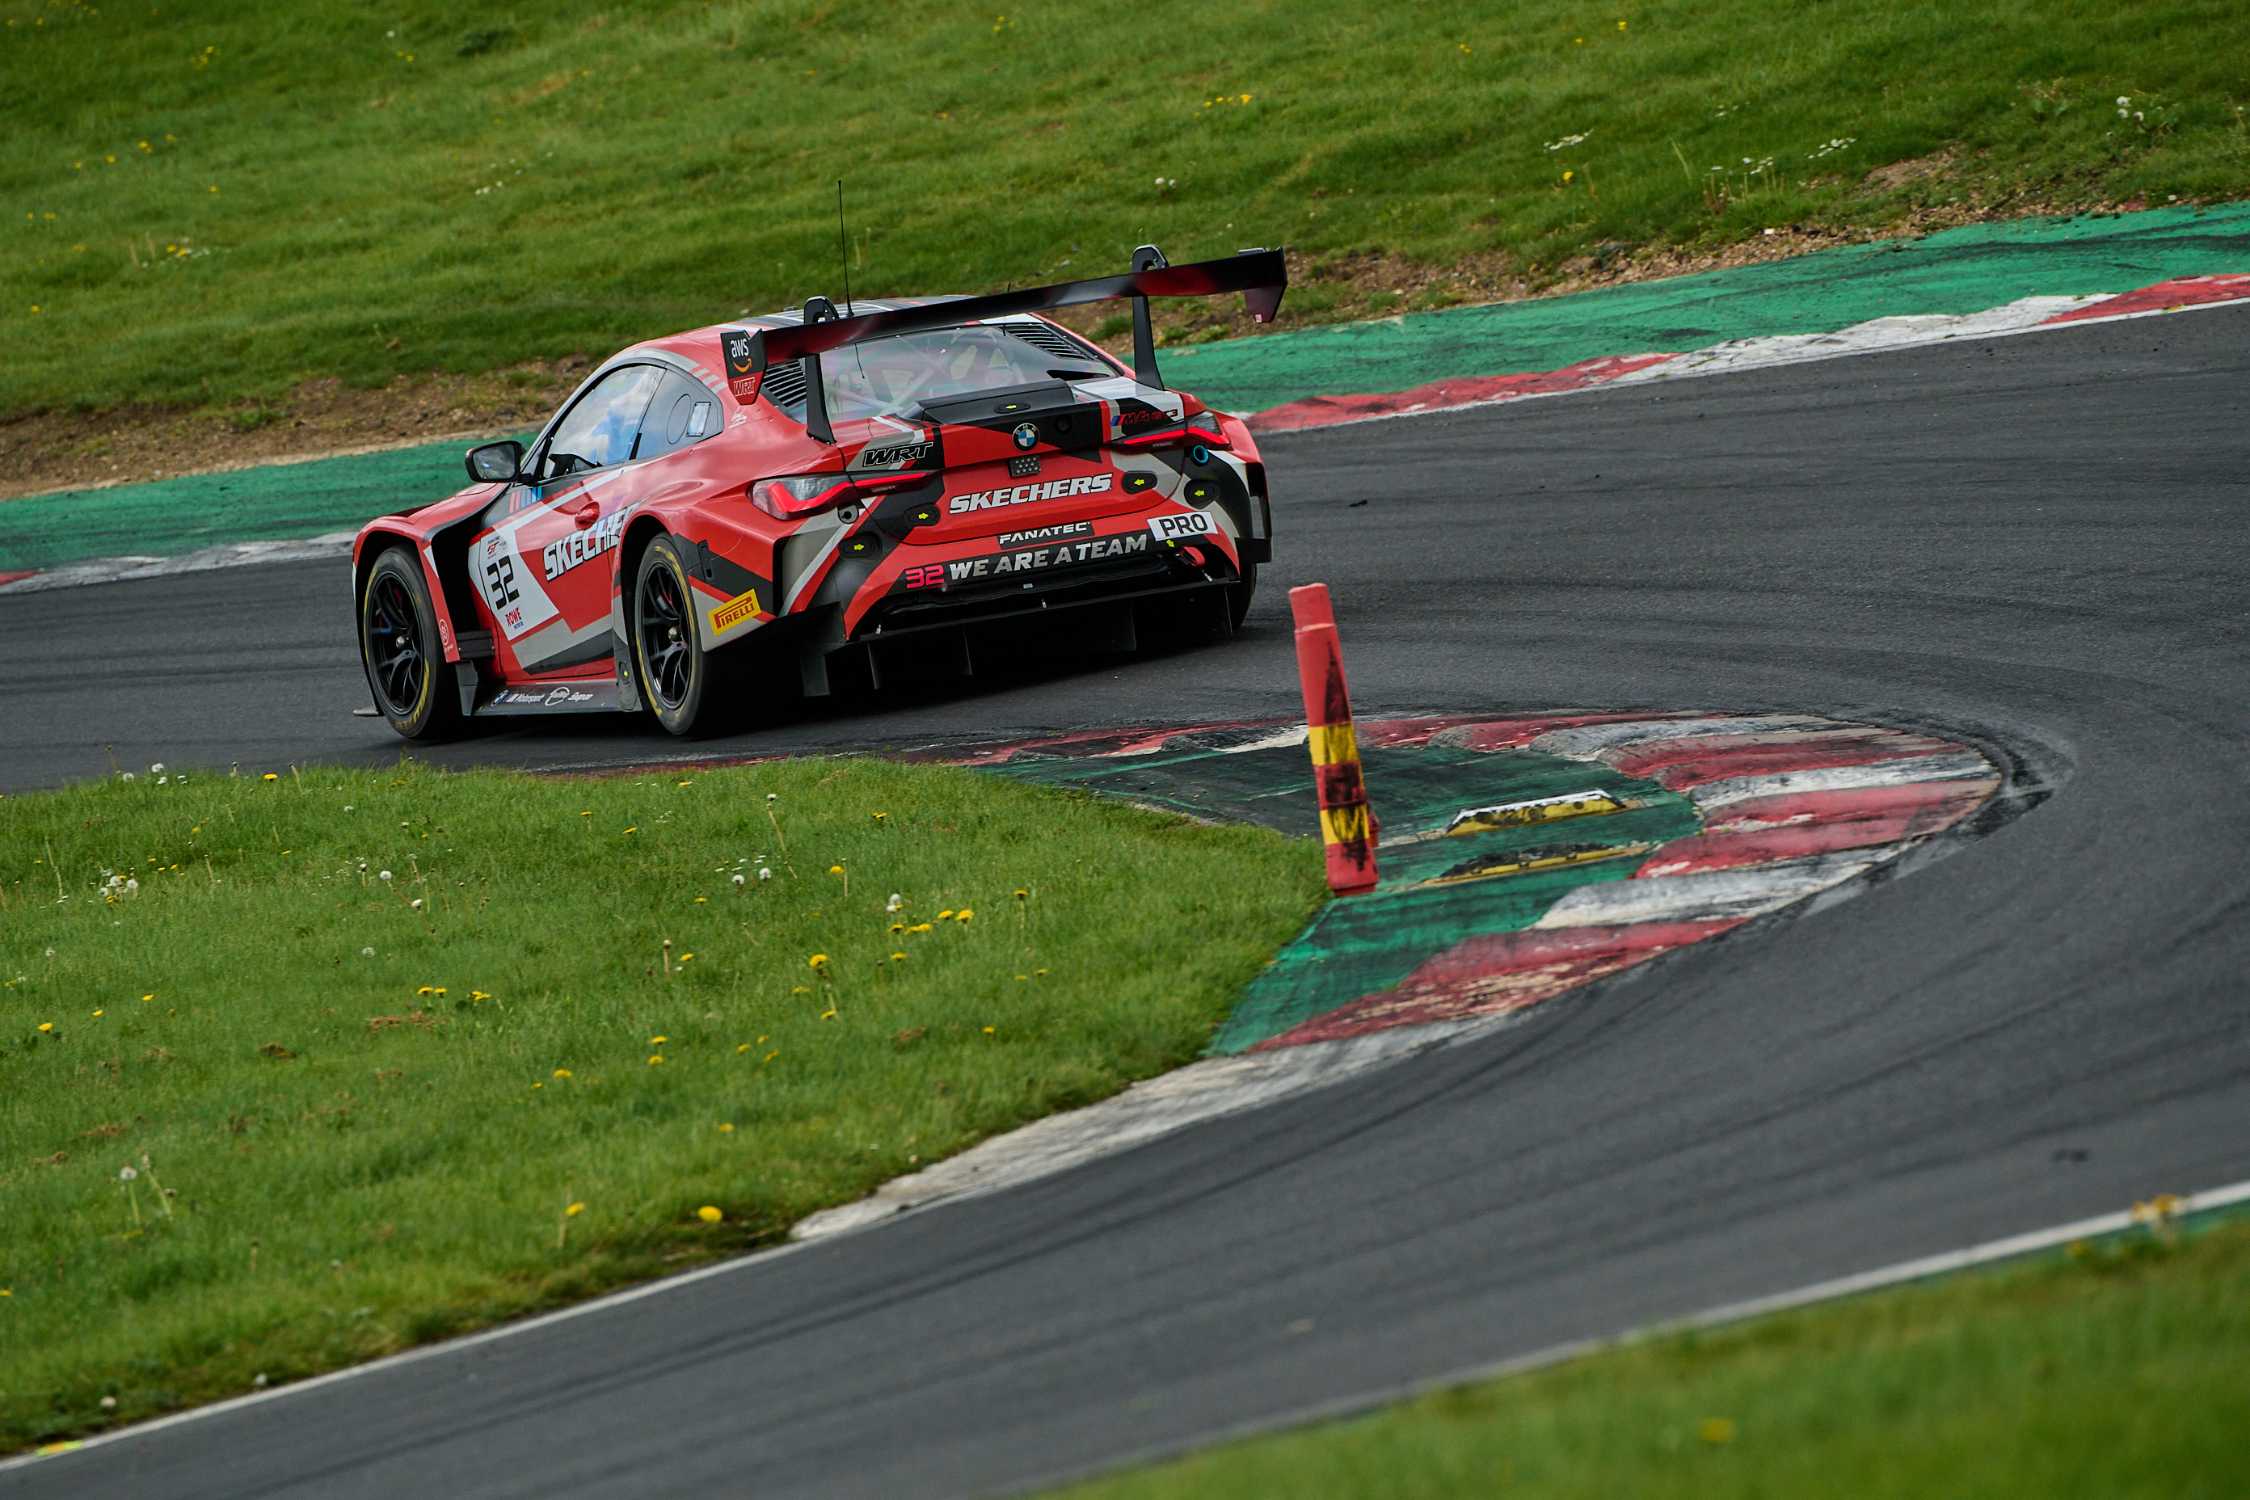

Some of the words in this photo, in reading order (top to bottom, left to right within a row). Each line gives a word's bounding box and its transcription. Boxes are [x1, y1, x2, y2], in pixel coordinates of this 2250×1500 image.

[731, 339, 749, 357] aws
[863, 441, 934, 467] WRT
[949, 474, 1112, 514] SKECHERS
[1000, 522, 1089, 544] FANATEC
[1159, 513, 1208, 537] PRO
[905, 565, 945, 589] 32
[949, 558, 989, 580] WE
[994, 549, 1049, 574] ARE
[1053, 546, 1072, 565] A
[1076, 534, 1147, 560] TEAM
[486, 555, 520, 610] 32
[713, 595, 754, 629] PIRELLI
